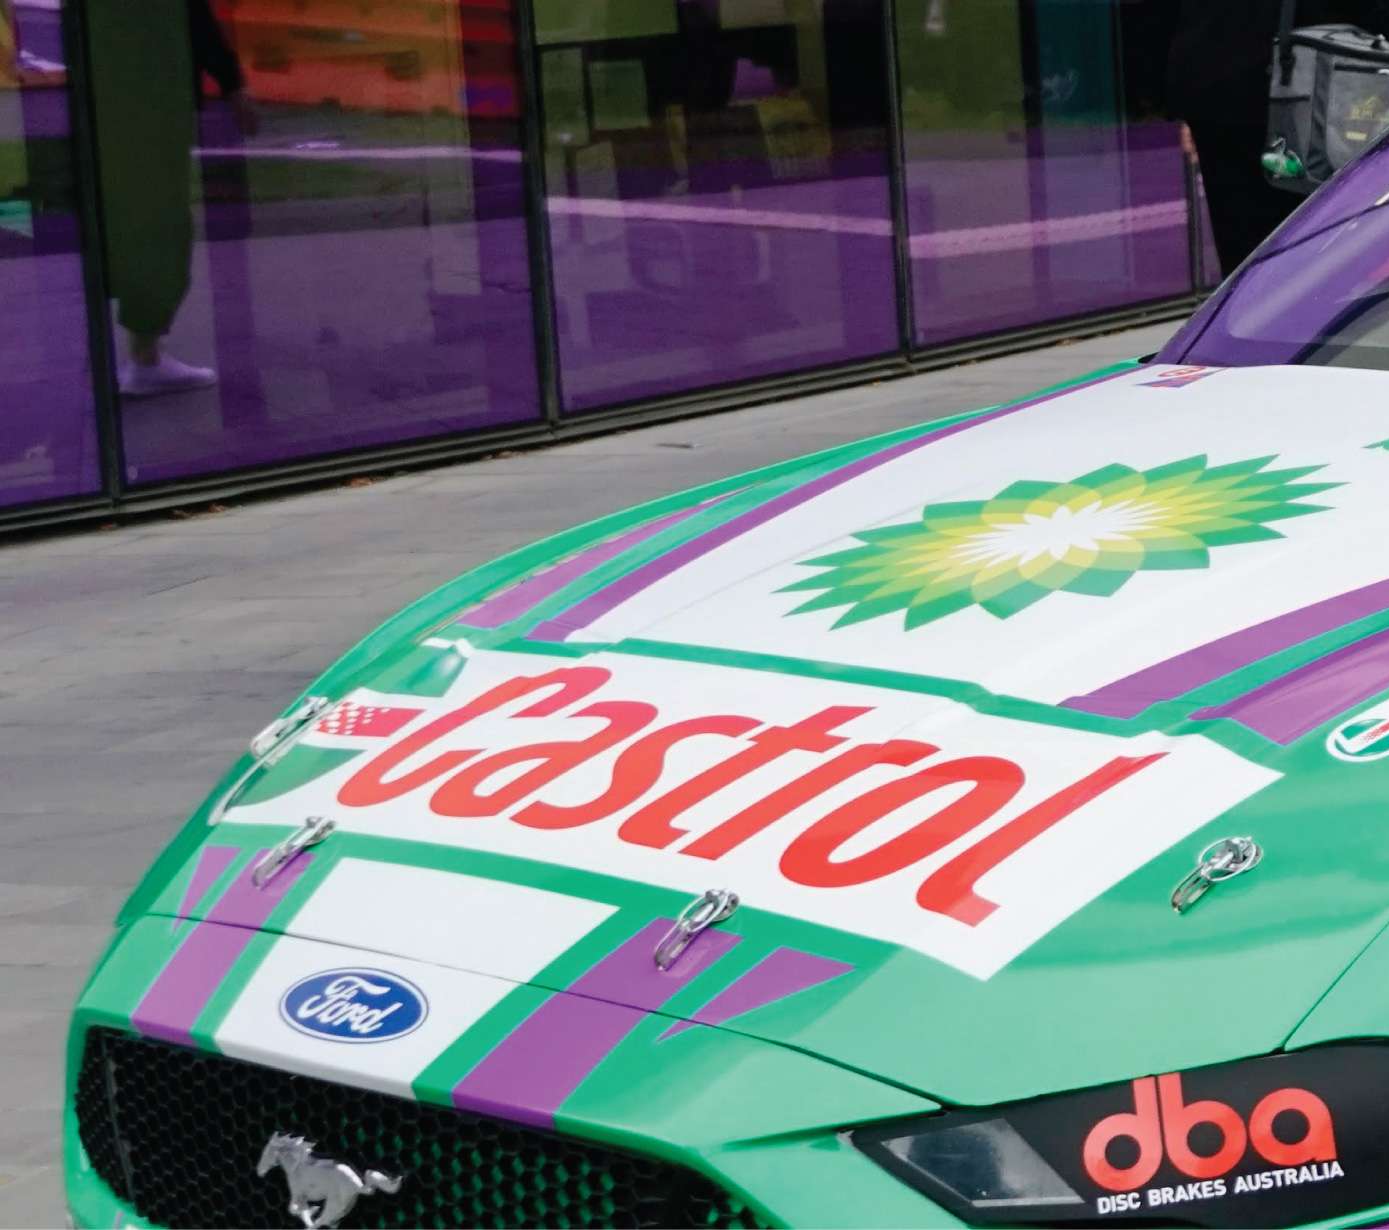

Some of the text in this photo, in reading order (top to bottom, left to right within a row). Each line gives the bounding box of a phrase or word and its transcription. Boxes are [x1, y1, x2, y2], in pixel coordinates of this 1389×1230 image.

[334, 665, 1171, 929] Castrol
[296, 975, 404, 1035] Ford
[1082, 1072, 1339, 1192] dba
[1096, 1160, 1345, 1216] DISC BRAKES AUSTRALIA
